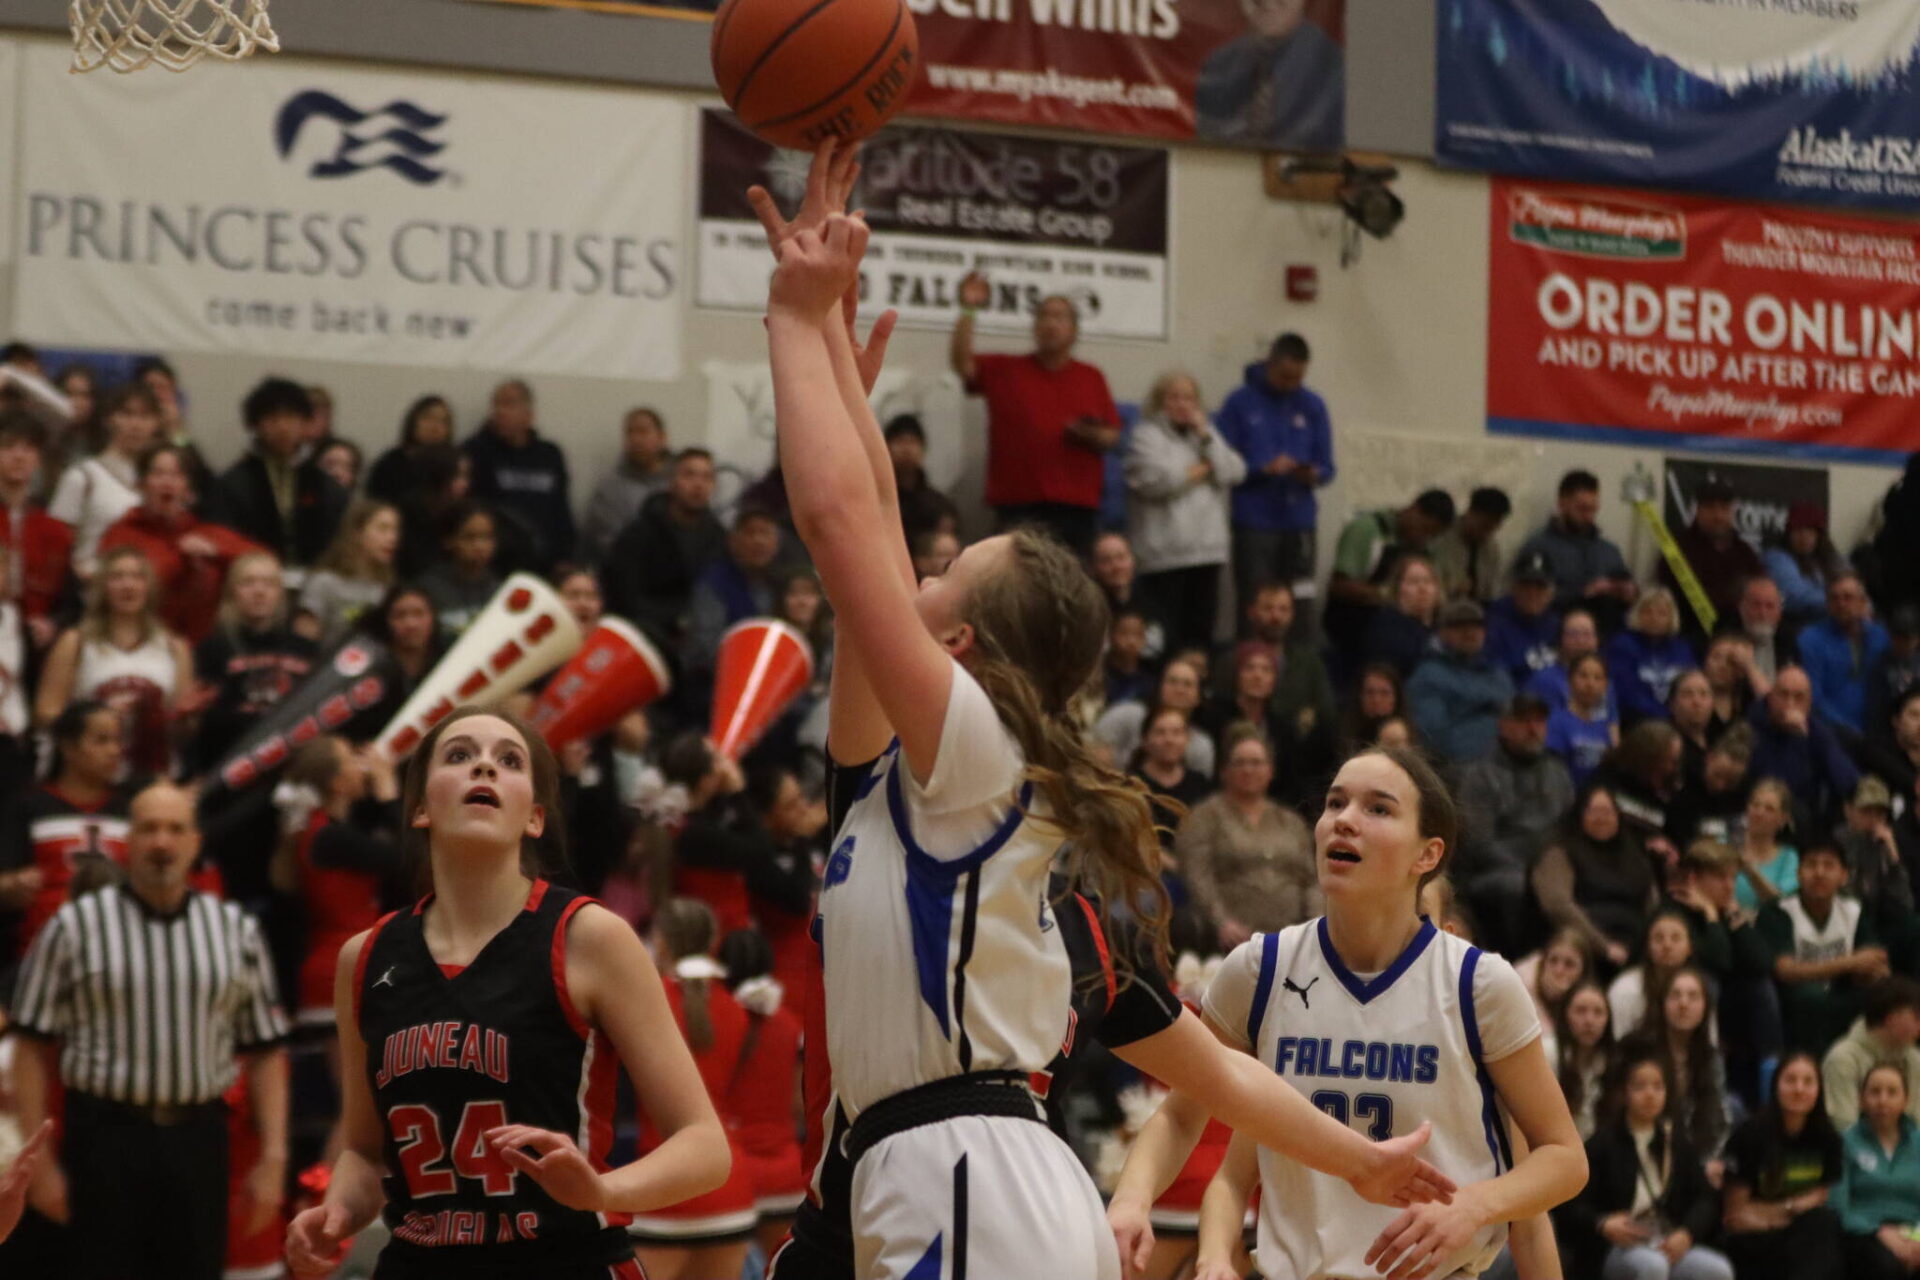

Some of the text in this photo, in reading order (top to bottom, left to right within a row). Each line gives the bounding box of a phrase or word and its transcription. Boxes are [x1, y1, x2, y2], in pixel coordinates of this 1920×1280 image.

[1056, 149, 1121, 207] 58
[26, 194, 676, 301] PRINCESS CRUISES
[898, 196, 1113, 244] Real Estate Group
[205, 297, 477, 340] come back new
[1538, 272, 1920, 361] ORDER ONLIN
[1538, 336, 1603, 370] AND
[1608, 341, 1675, 378] PICK
[1678, 348, 1719, 380] UP
[1721, 353, 1808, 389] AFTER
[1812, 359, 1865, 394] THE
[376, 1020, 509, 1090] JUNEAU
[1275, 1036, 1440, 1084] FALCONS
[388, 1100, 519, 1199] 24
